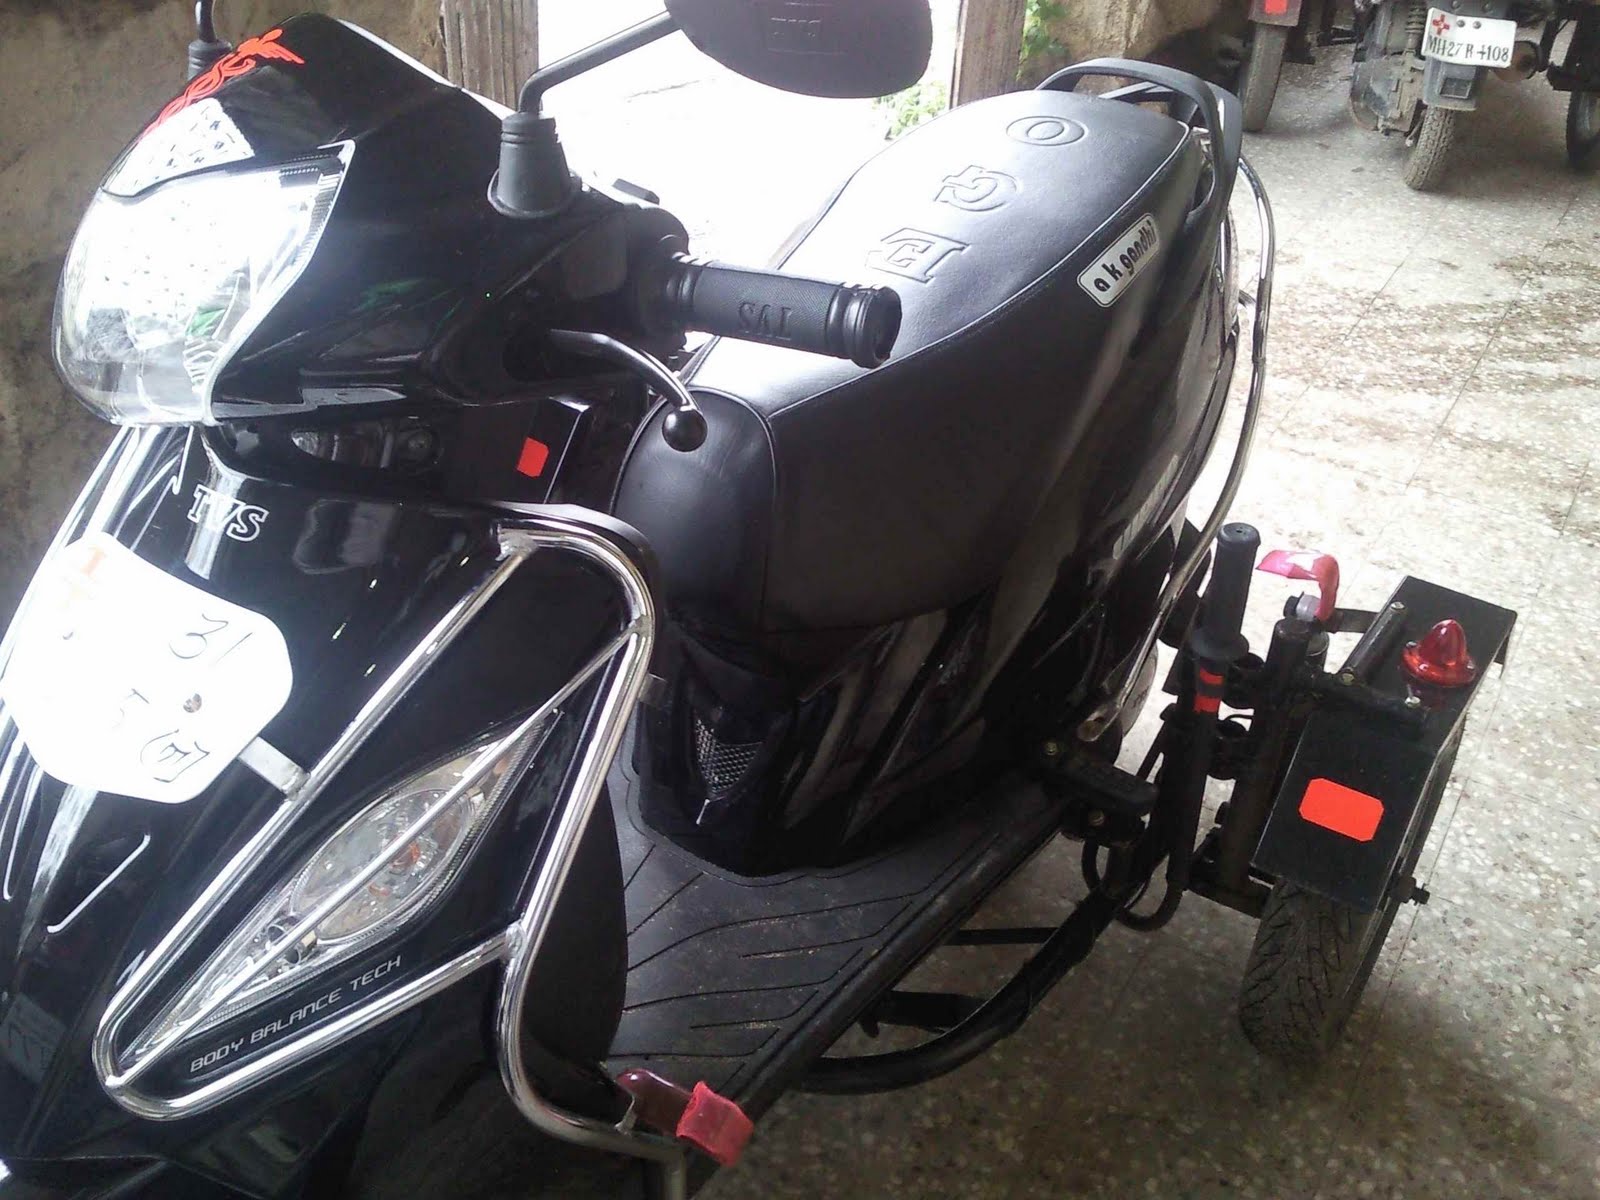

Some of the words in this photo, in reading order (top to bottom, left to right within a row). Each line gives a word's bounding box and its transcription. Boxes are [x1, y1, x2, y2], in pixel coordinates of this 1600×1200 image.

[1101, 263, 1123, 281] k
[187, 483, 270, 542] TVS
[190, 1037, 244, 1073] BODY
[250, 987, 342, 1045] BALANCE
[349, 954, 401, 992] TECH
